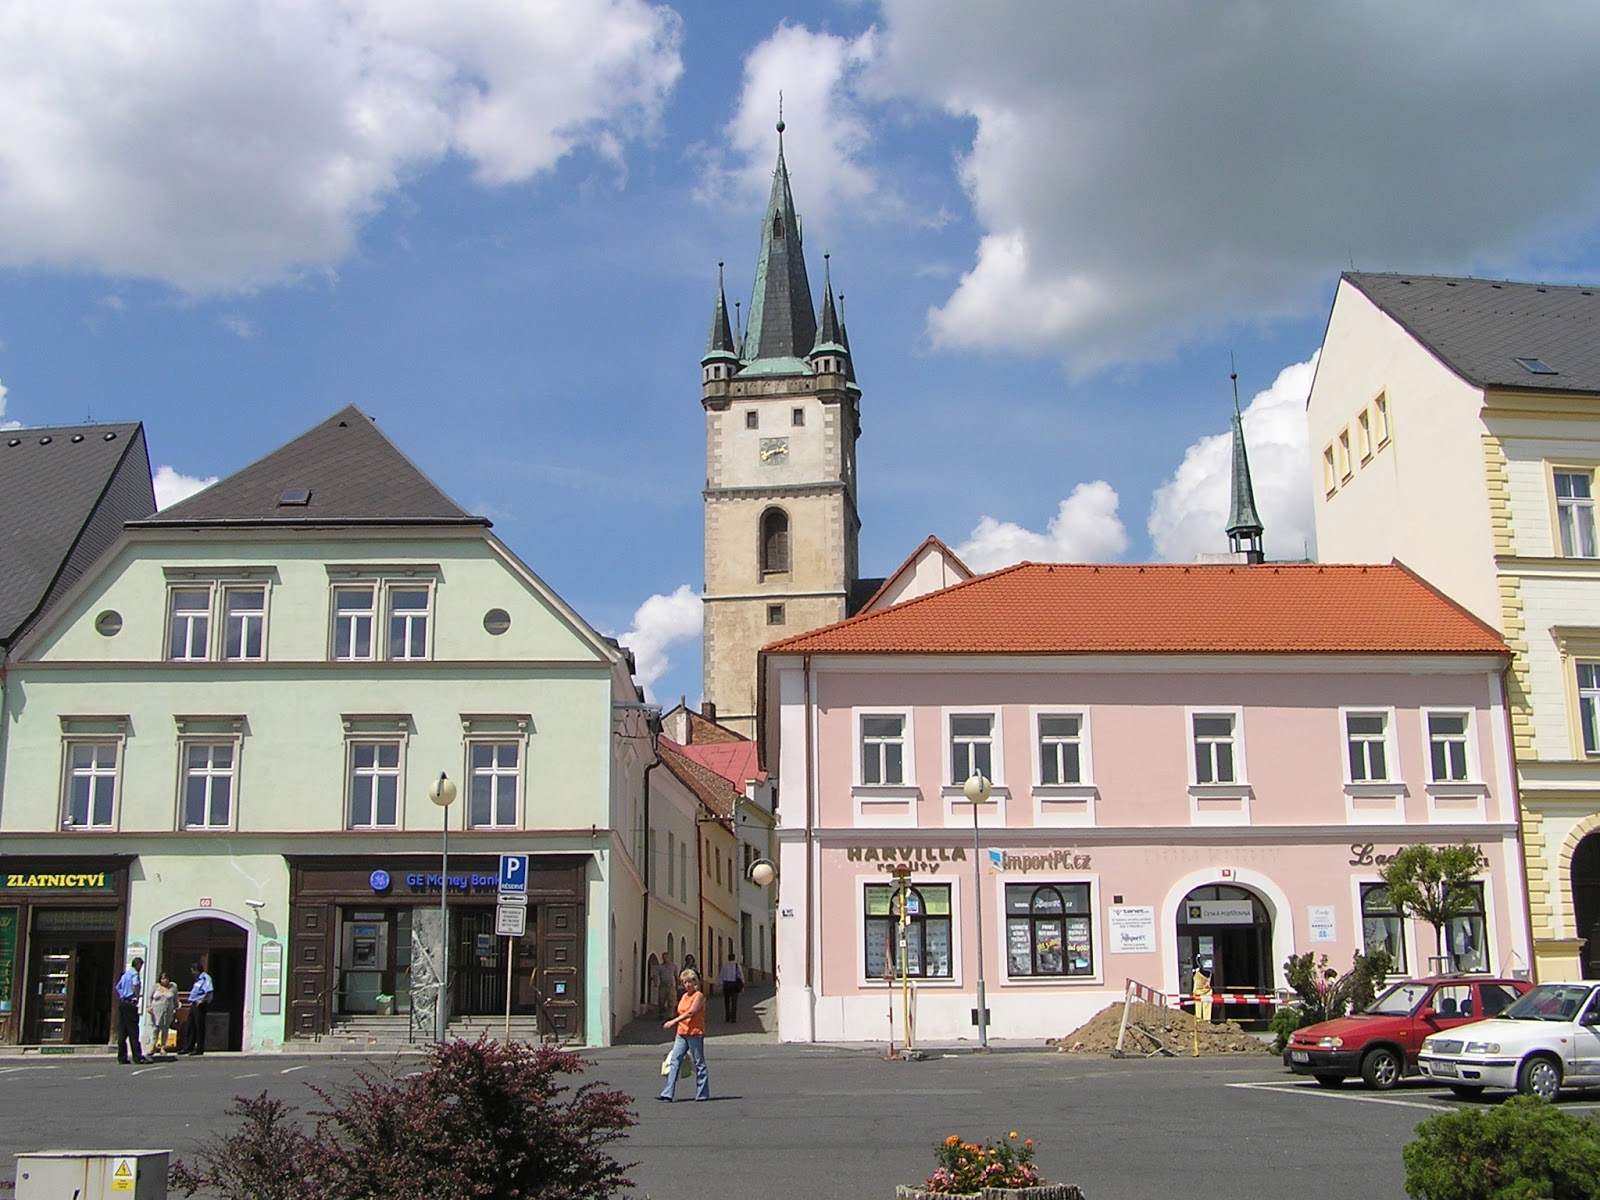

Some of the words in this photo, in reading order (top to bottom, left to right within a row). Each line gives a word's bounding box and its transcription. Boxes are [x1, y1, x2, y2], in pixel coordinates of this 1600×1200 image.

[846, 846, 967, 861] HARVILLA
[507, 858, 520, 879] P
[7, 872, 104, 887] ZLATNICTVÍ
[407, 873, 424, 886] GE
